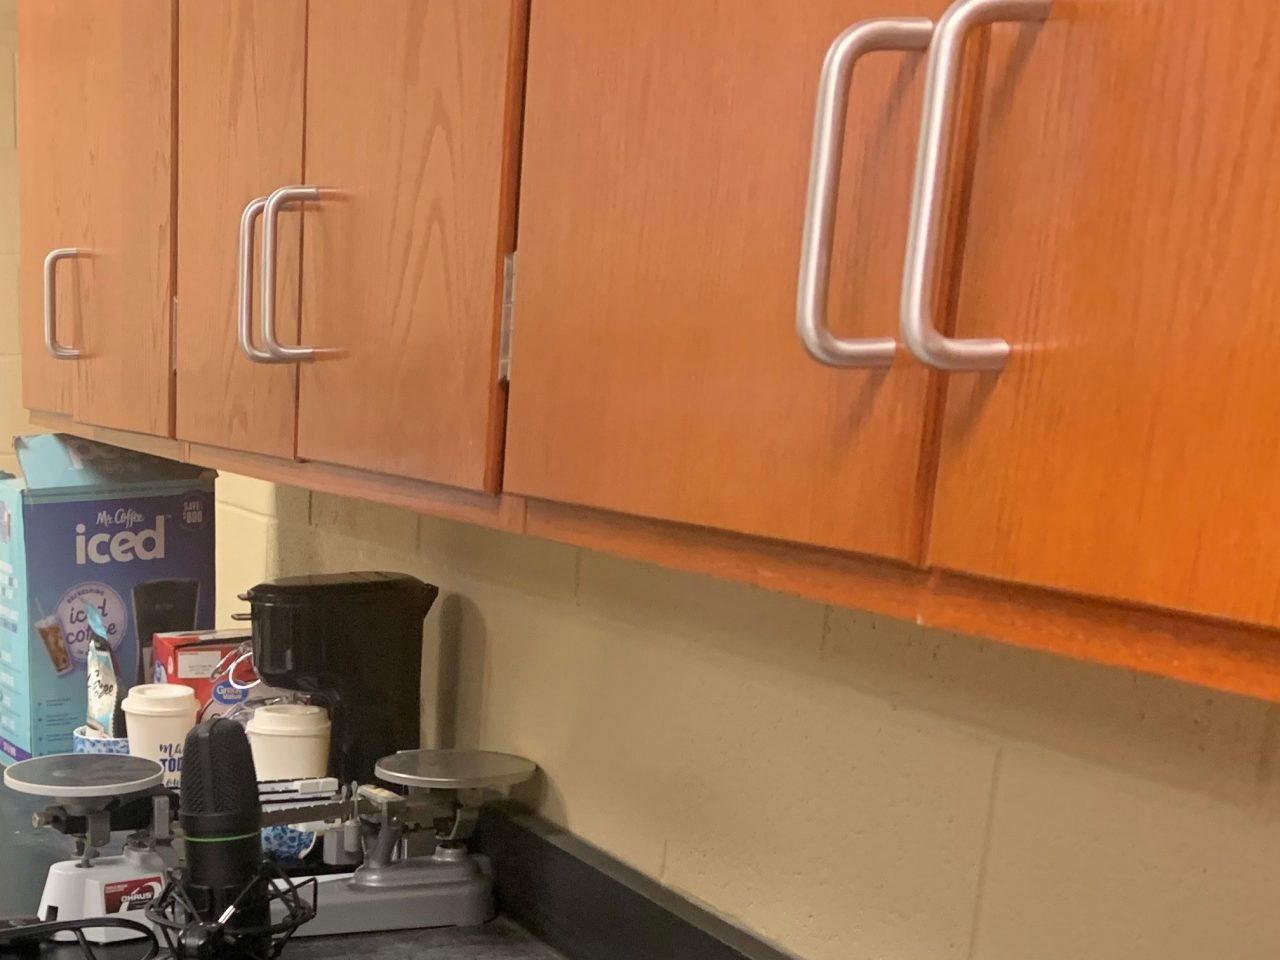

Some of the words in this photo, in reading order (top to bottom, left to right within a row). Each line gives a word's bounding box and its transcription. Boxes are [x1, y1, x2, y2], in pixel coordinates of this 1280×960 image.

[114, 508, 145, 529] Coffee
[75, 515, 165, 565] iced
[121, 892, 152, 902] OHAUS
